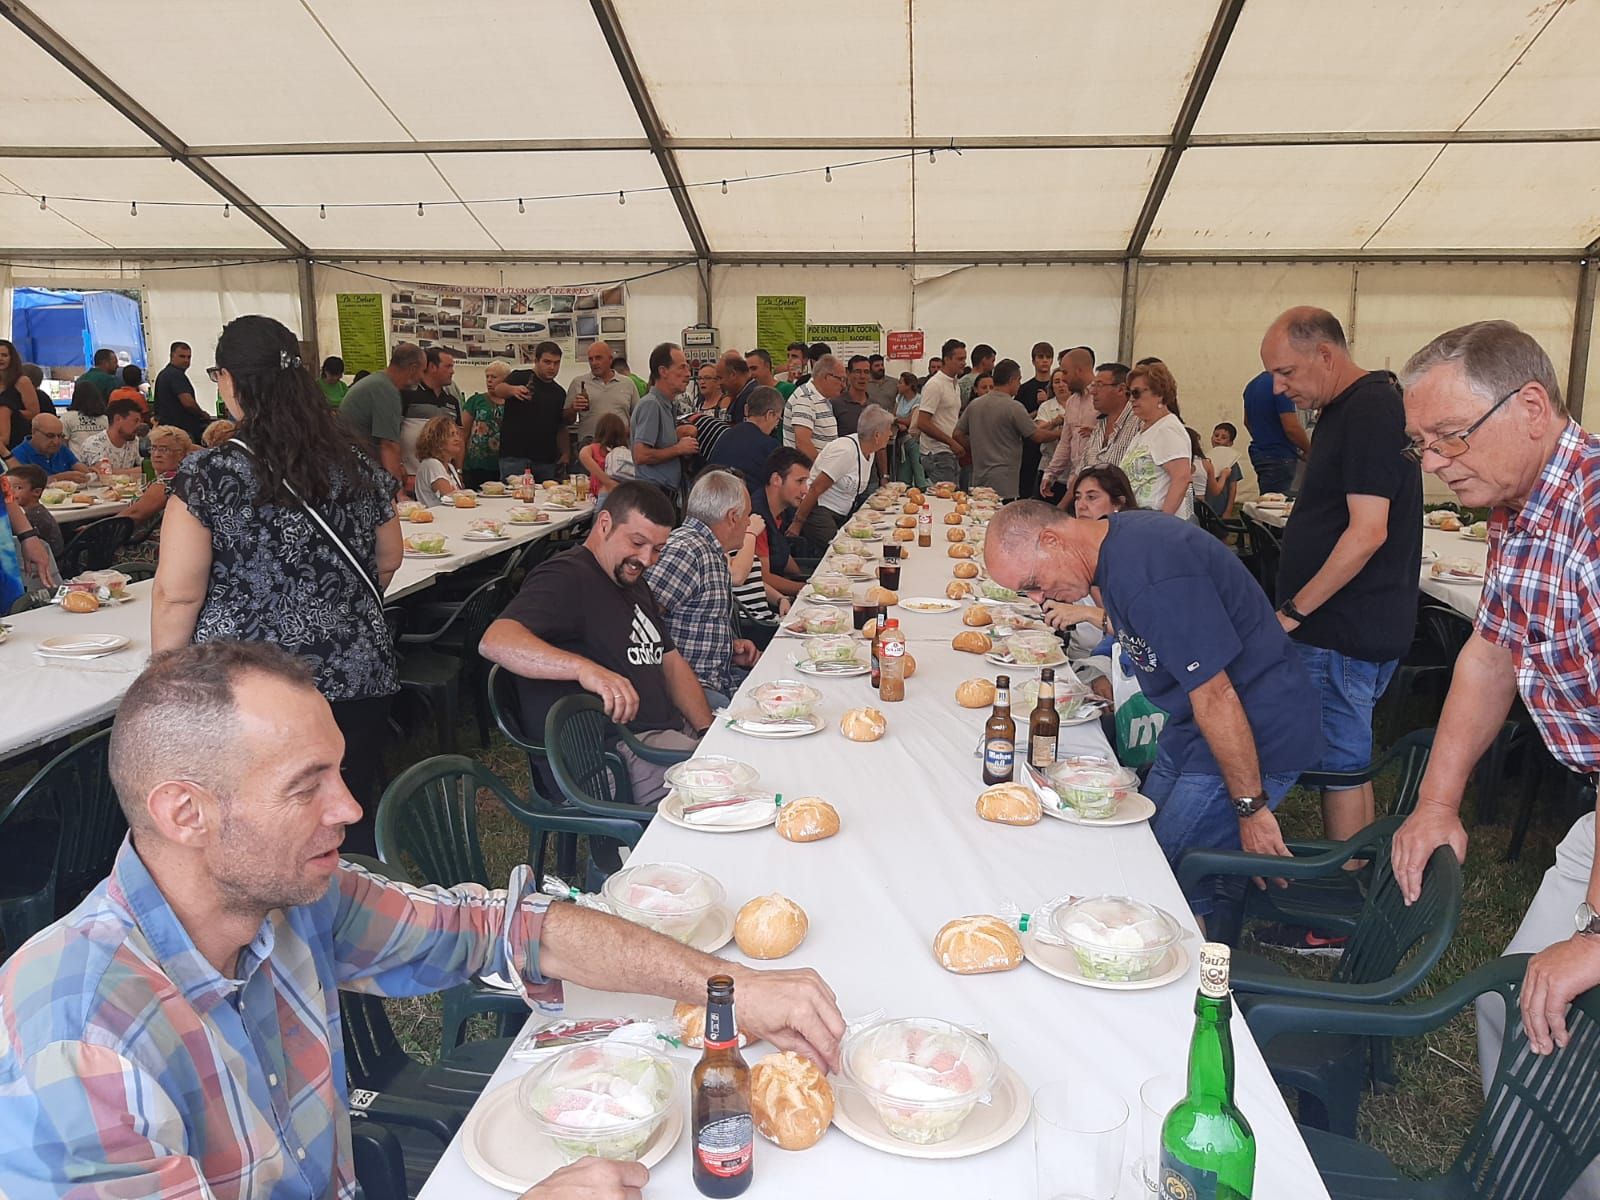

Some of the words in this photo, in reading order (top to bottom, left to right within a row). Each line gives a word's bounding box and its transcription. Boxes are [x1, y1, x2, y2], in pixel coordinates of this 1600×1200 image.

[463, 287, 539, 295] AUTOMATISMOS
[549, 287, 590, 295] CIERRES
[808, 326, 820, 334] PIDE
[830, 325, 855, 333] NUESTRA
[856, 325, 879, 333] COCINA
[627, 642, 664, 665] adida
